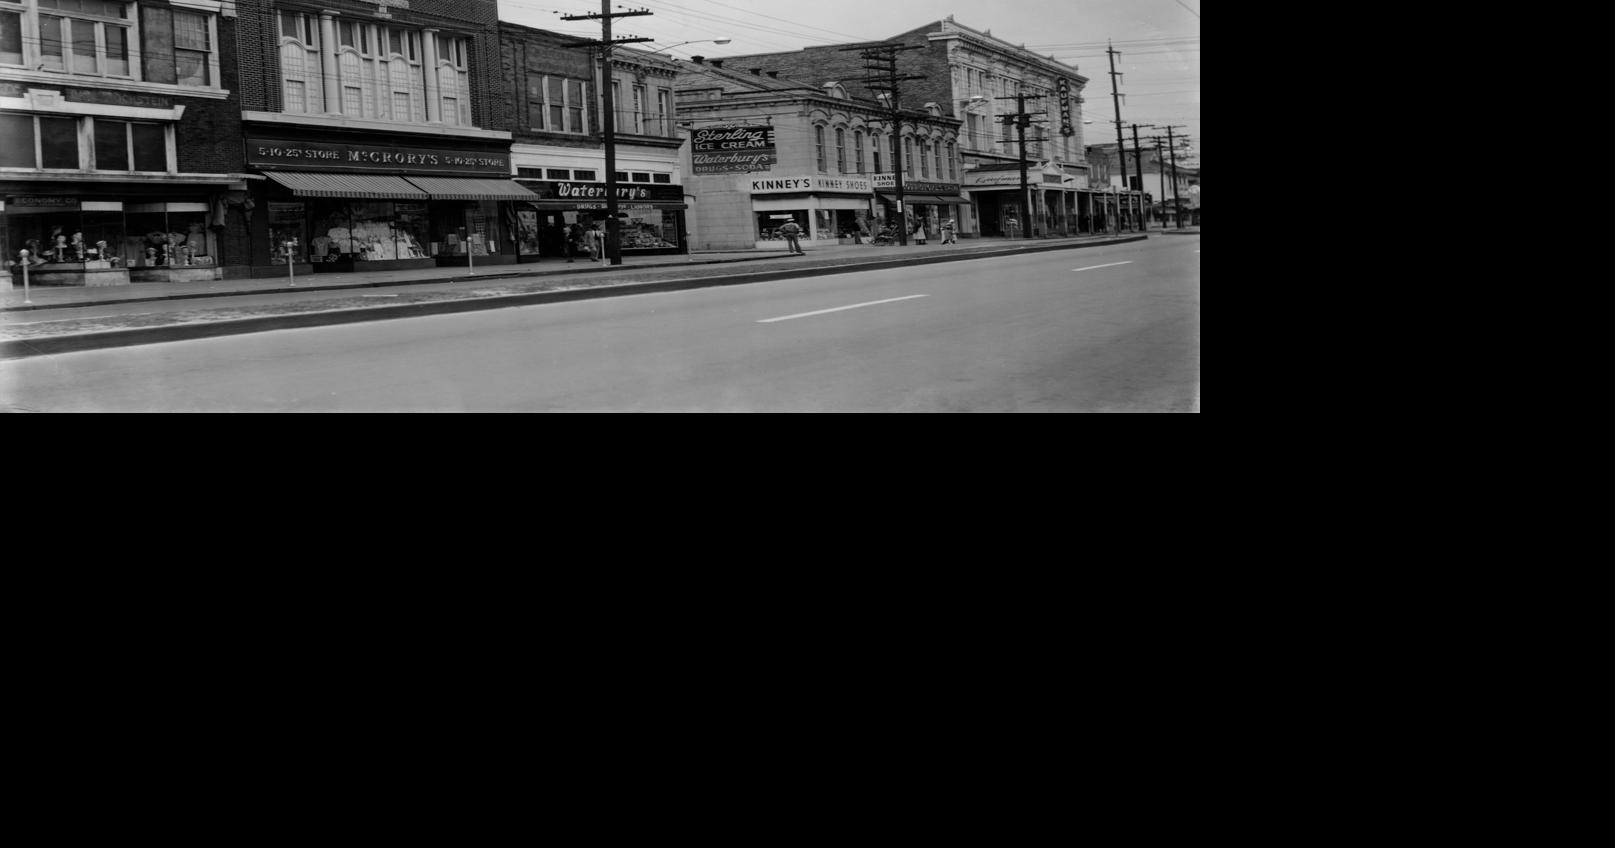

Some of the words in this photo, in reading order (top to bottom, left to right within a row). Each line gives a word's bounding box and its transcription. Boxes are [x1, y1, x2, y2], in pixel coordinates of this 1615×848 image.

[693, 128, 764, 144] Sterling
[720, 141, 766, 149] CREAM
[305, 150, 340, 159] STORE
[693, 153, 768, 165] Waterbury's
[478, 158, 505, 167] STORE
[752, 178, 810, 190] KINNEY'S
[818, 178, 843, 189] KINNEY
[846, 180, 868, 191] SHOES
